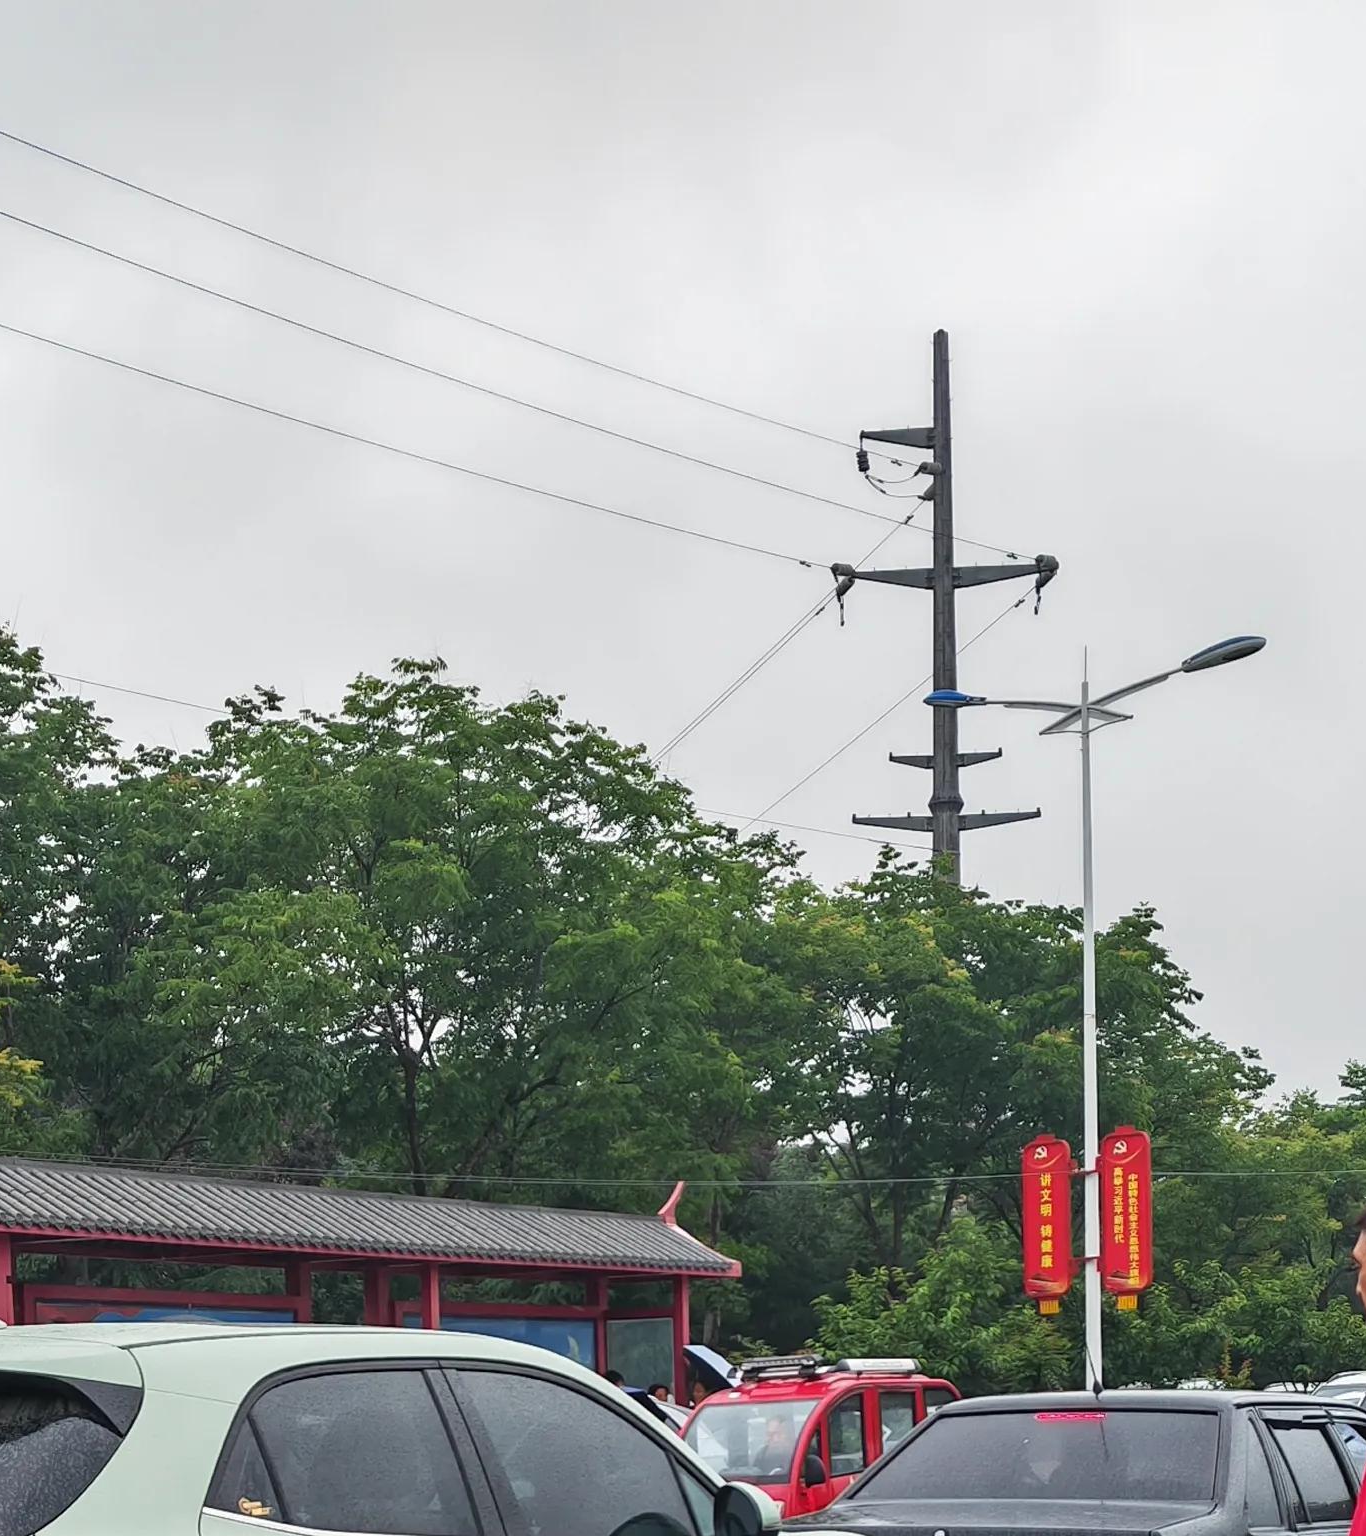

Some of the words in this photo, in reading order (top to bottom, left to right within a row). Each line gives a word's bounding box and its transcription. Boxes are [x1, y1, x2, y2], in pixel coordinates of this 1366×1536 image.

[1039, 1173, 1053, 1217] 讲文明
[1113, 1167, 1125, 1244] 高举习近平新时代
